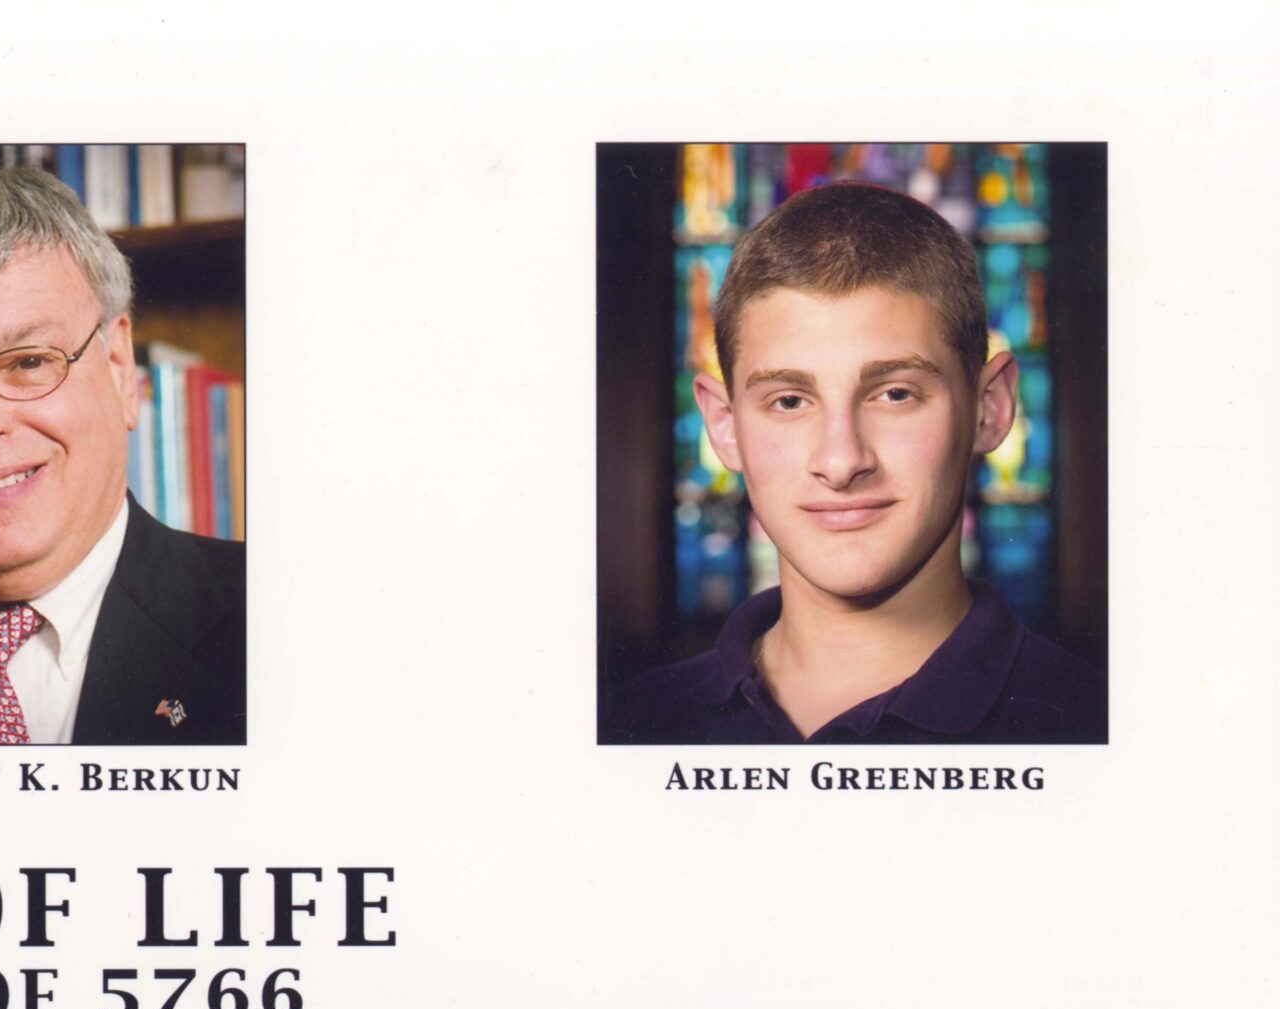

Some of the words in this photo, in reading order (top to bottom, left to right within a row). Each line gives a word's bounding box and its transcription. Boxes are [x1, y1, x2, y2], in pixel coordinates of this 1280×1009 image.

[19, 763, 59, 791] K.
[80, 763, 241, 791] BERKUN
[665, 762, 791, 790] ARLEN
[810, 761, 1044, 791] GREENBERG
[136, 867, 396, 947] LIFE
